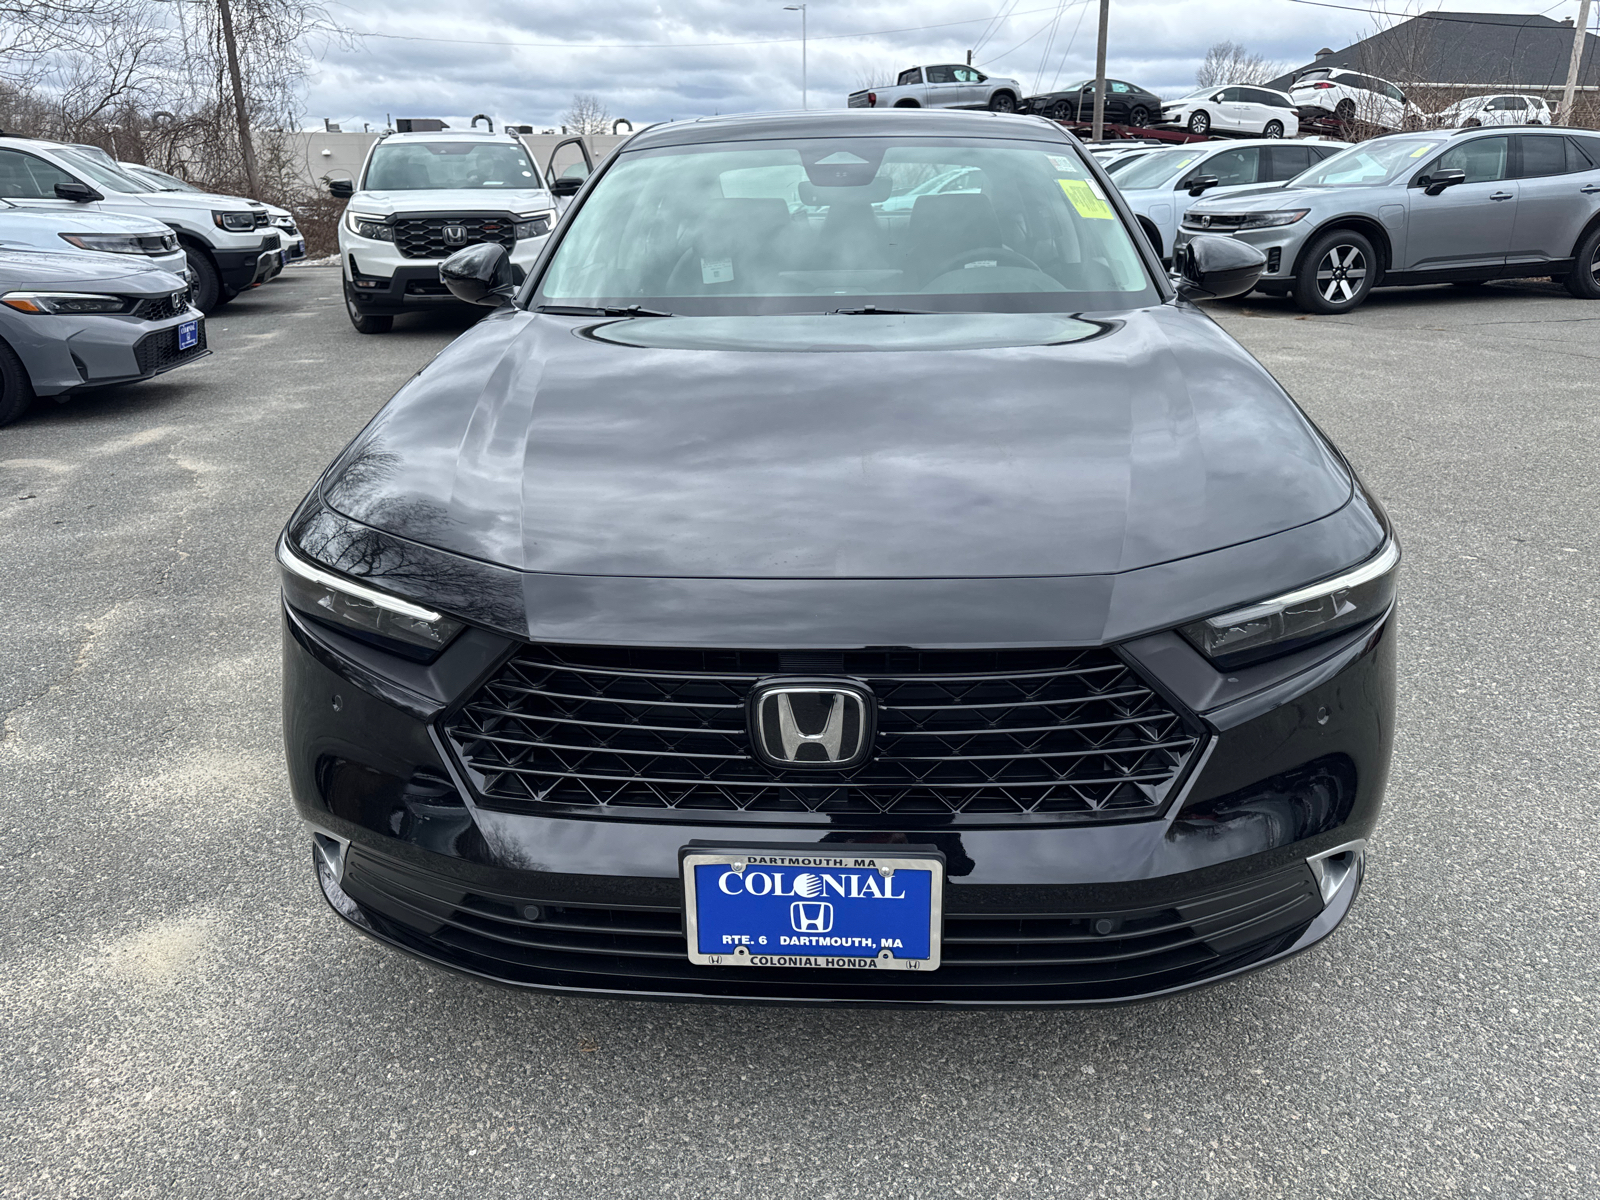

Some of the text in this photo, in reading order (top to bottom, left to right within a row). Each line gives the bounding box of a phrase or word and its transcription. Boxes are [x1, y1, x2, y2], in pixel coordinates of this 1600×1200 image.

[747, 856, 876, 868] DARTMOUTH, MA
[718, 871, 905, 899] COLONIAL
[722, 935, 768, 945] RTE. 6
[779, 935, 904, 949] DARTMOUTH, MA
[750, 956, 878, 968] COLONIAL HONDA
